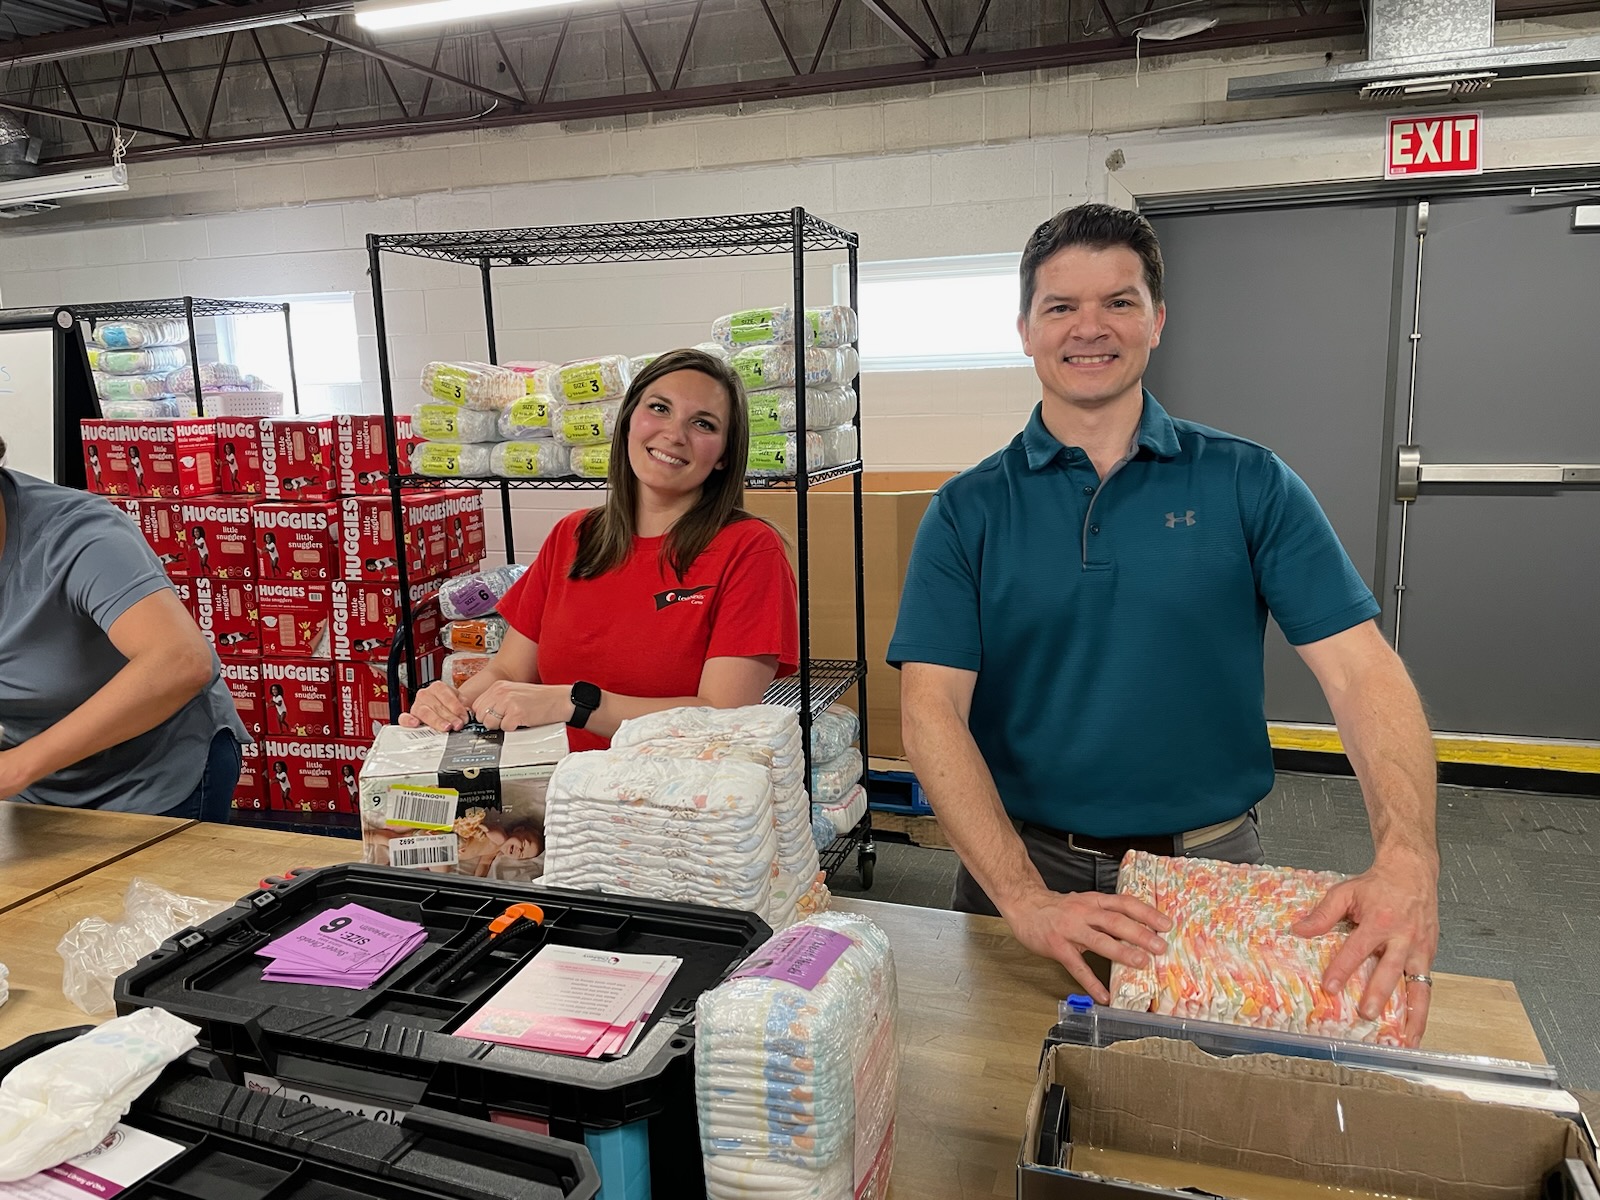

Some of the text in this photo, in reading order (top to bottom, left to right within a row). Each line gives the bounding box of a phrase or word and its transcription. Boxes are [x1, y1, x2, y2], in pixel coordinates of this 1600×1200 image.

[1392, 118, 1475, 165] EXIT
[753, 363, 762, 376] 4
[454, 386, 461, 398] 3
[590, 380, 599, 392] 3
[537, 405, 545, 417] 3
[768, 408, 778, 421] 4
[446, 420, 453, 432] 3
[590, 424, 600, 436] 3
[120, 425, 176, 442] HUGGIES
[259, 420, 280, 500] HUGGIES
[337, 415, 356, 495] HUGGIES
[774, 451, 784, 464] 4
[447, 457, 455, 469] 3
[525, 458, 533, 470] 3
[173, 486, 180, 495] 6
[171, 504, 180, 512] 6
[409, 502, 446, 526] HUGGIES
[181, 505, 250, 524] HUGGIES
[253, 511, 327, 530] HUGGIES
[363, 516, 371, 536] little
[296, 533, 314, 541] little
[342, 500, 362, 581] HUGGIES
[288, 541, 323, 549] snugglers
[243, 567, 251, 577] 6
[319, 568, 326, 578] 6
[259, 584, 305, 597] HUGGIES
[382, 587, 392, 596] 6
[478, 589, 490, 601] 6
[331, 581, 351, 660] HUGGIES
[475, 634, 483, 647] 2
[262, 663, 330, 682] HUGGIES
[294, 692, 326, 700] snugglers
[342, 686, 354, 736] HUGGIES
[253, 723, 260, 732] 6
[323, 725, 331, 735] 6
[265, 741, 334, 759] HUGGIES
[299, 769, 332, 777] snugglers
[253, 799, 260, 808] 6
[328, 800, 336, 810] 6
[319, 916, 352, 933] 6
[339, 930, 371, 946] SIZE:
